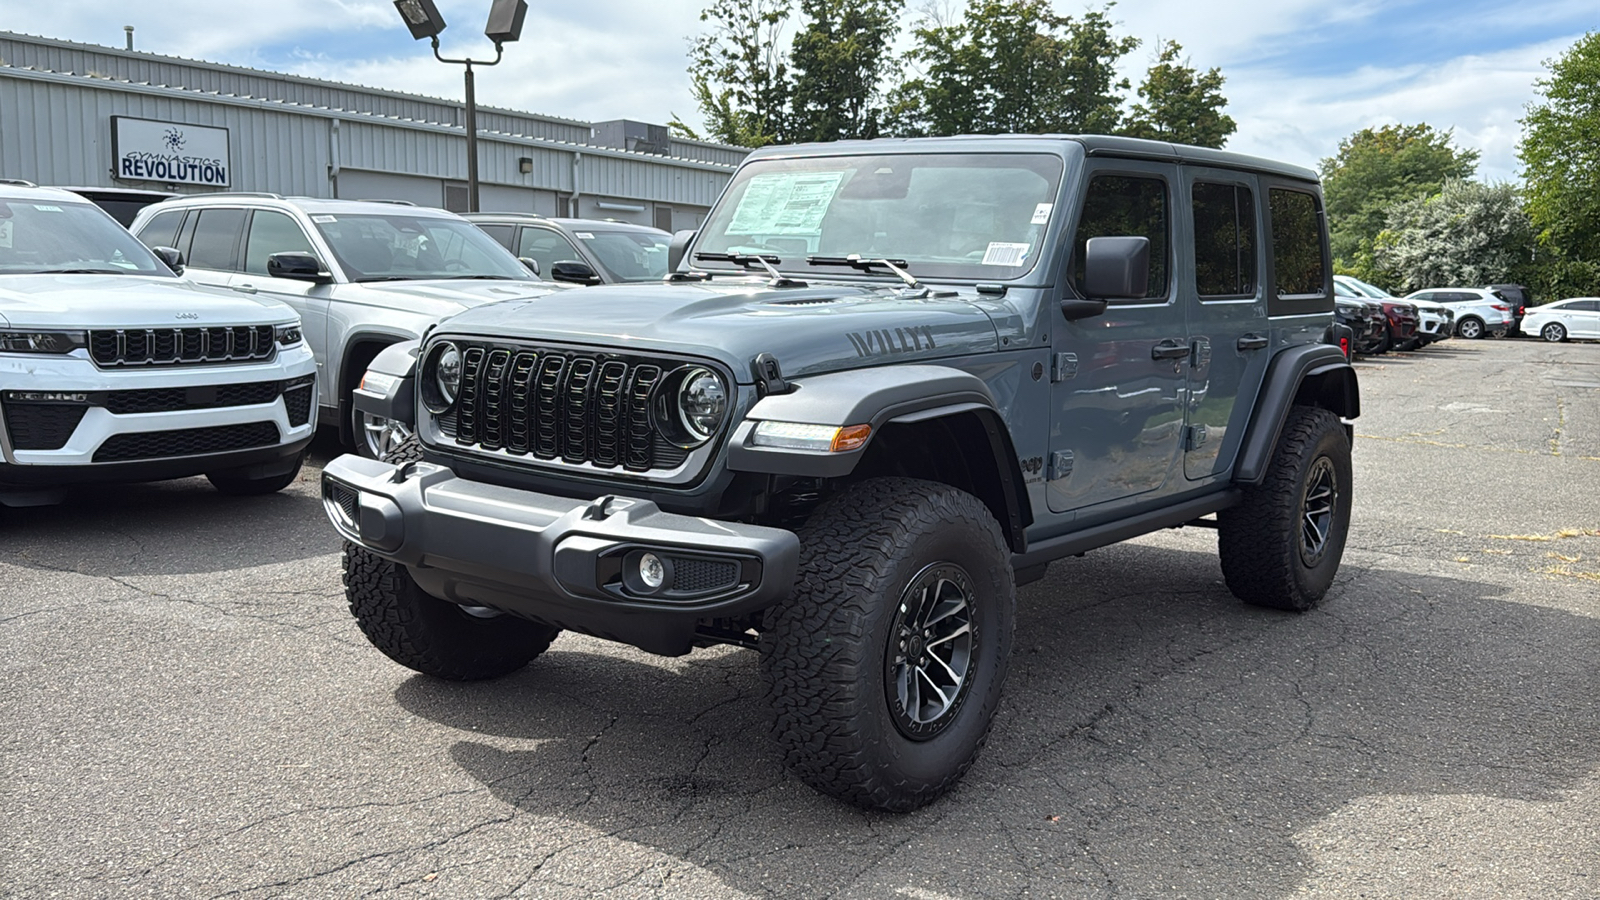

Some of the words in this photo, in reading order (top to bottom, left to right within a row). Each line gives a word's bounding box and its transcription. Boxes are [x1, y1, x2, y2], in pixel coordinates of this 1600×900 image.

[121, 157, 226, 184] REVOLUTION
[125, 151, 221, 167] GYMNASTICS
[845, 324, 936, 357] WILLYS
[1018, 455, 1043, 475] eep
